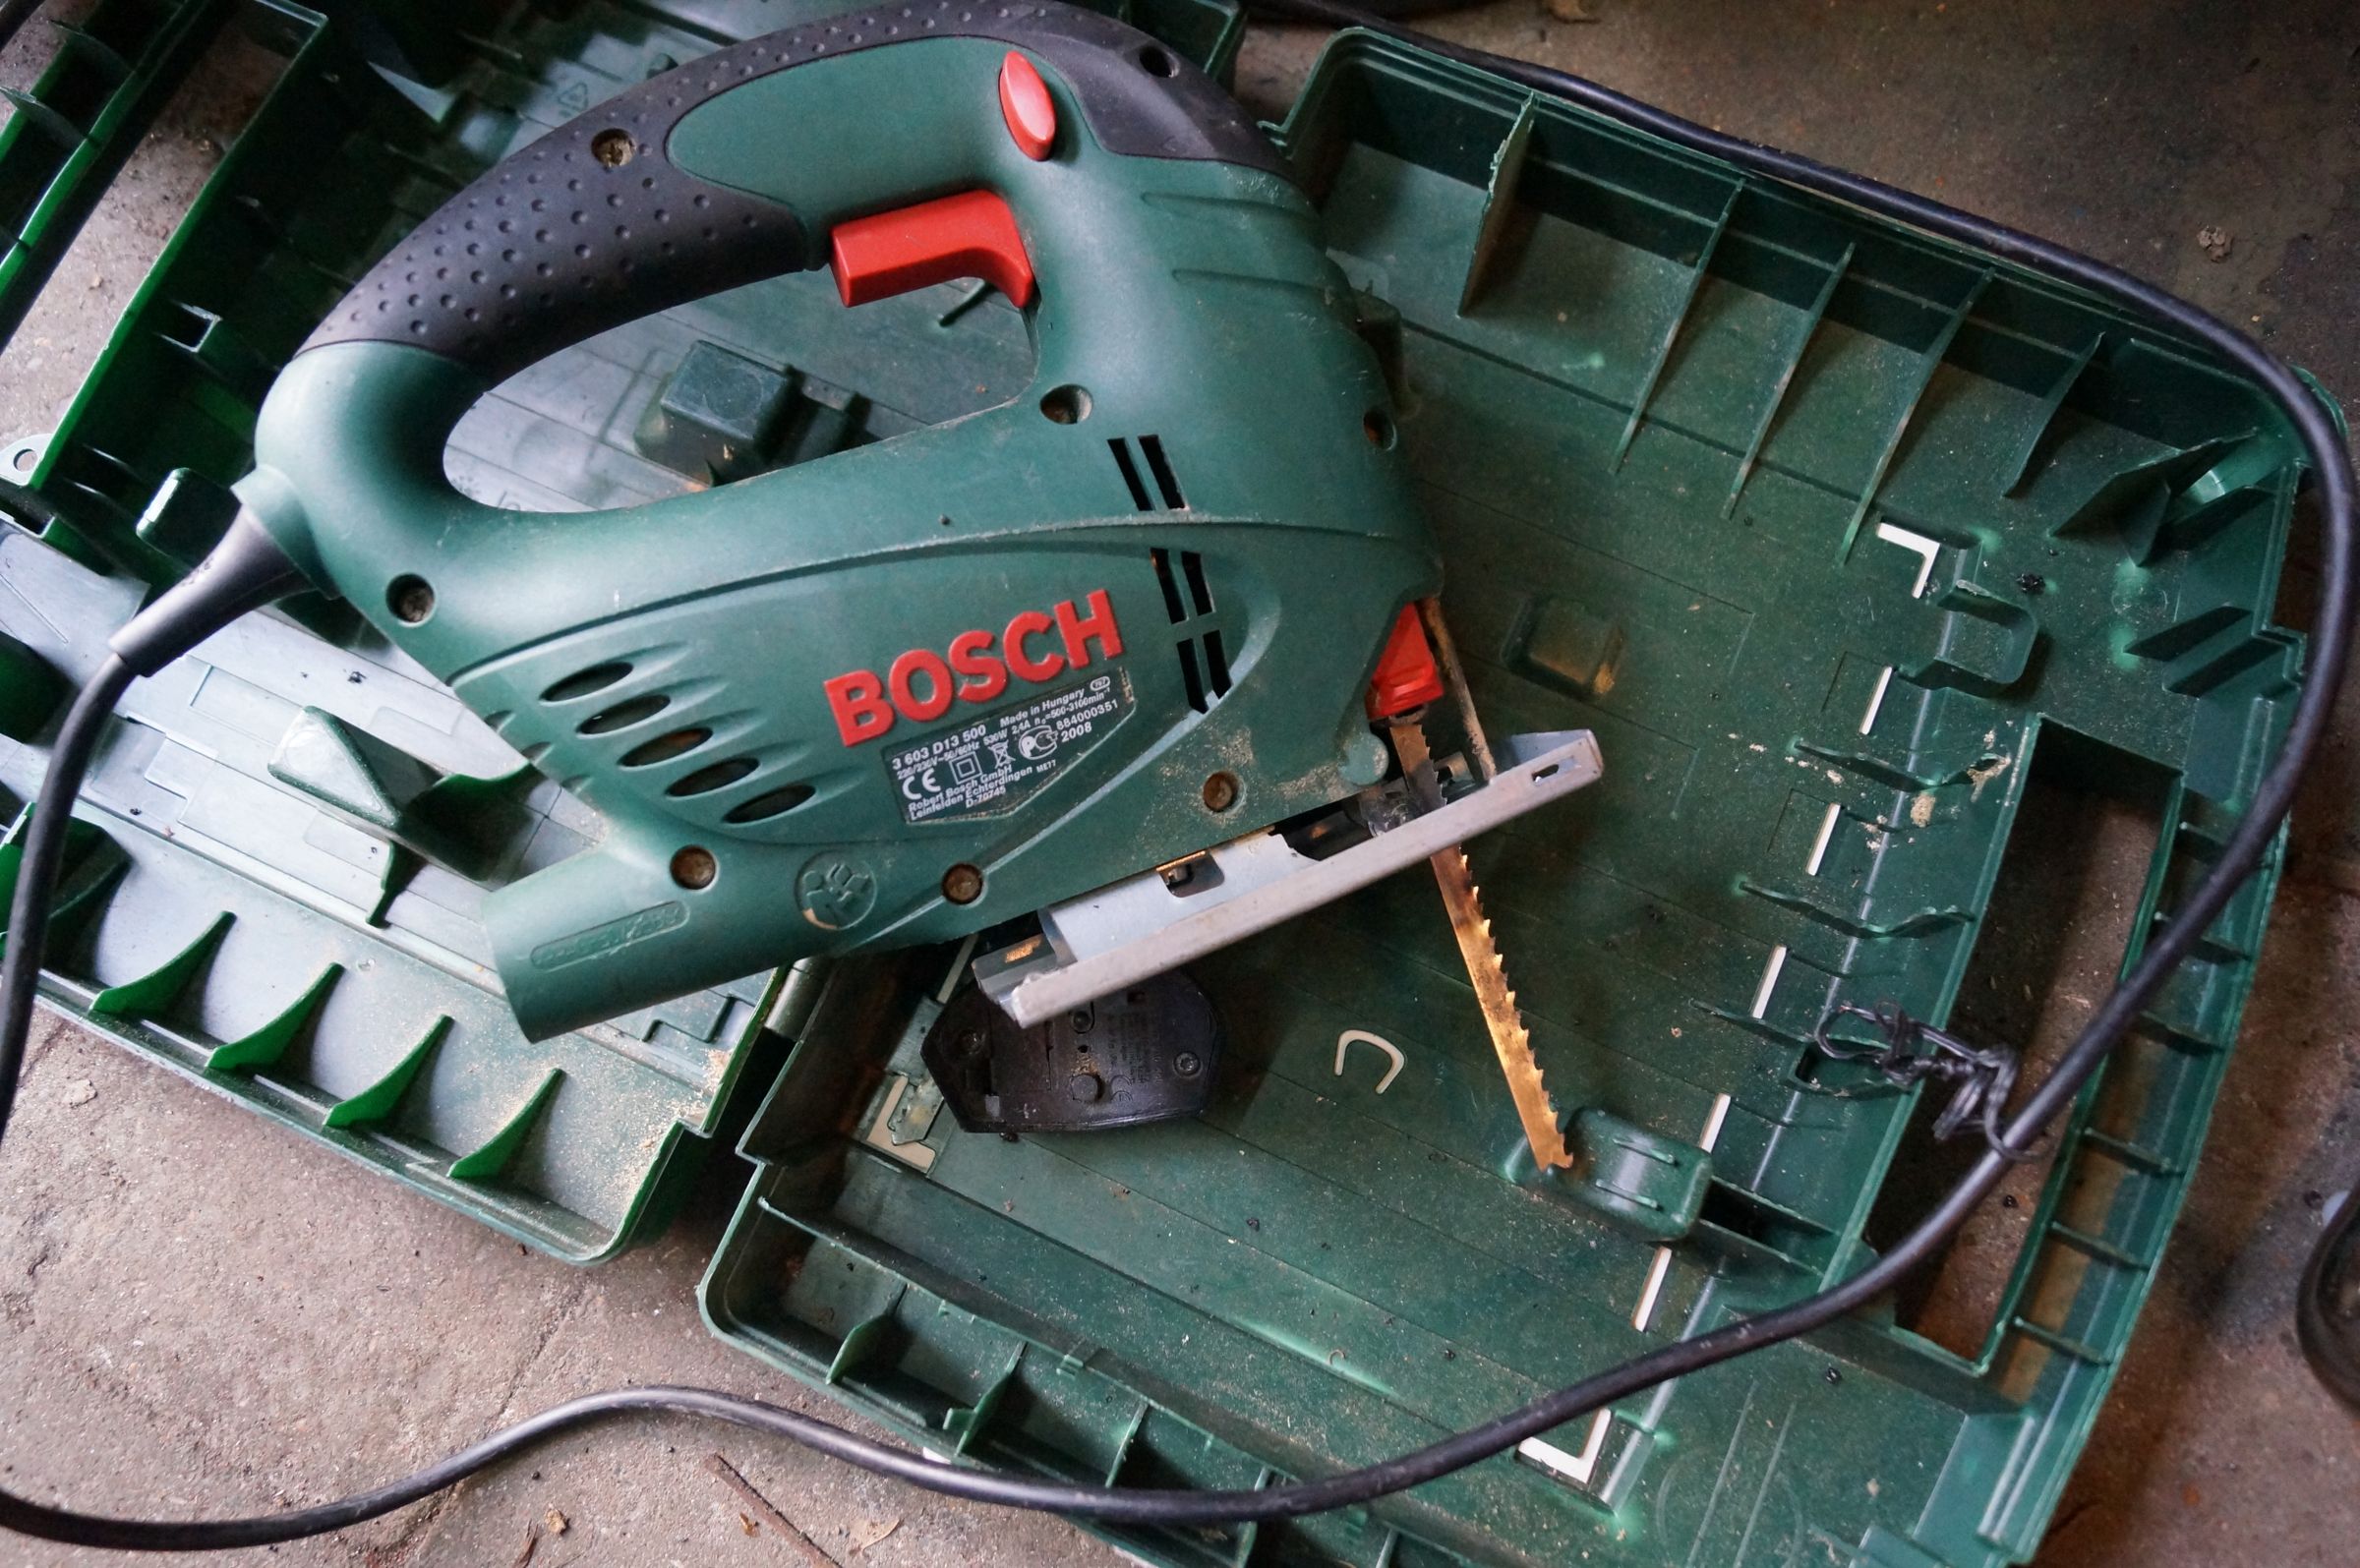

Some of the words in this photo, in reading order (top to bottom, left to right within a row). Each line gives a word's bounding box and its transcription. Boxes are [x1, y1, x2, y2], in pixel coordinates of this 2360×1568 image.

[824, 588, 1124, 747] BOSCH
[1000, 710, 1029, 728] Made
[1030, 703, 1040, 717] in
[1042, 688, 1085, 712] Hungary
[1056, 699, 1119, 730] 884000351
[892, 757, 903, 770] 3
[904, 747, 929, 766] 603
[932, 735, 959, 756] D13
[962, 725, 987, 743] 500
[1060, 723, 1092, 743] 2008
[902, 767, 942, 800] CE
[909, 791, 945, 813] Robert
[946, 780, 978, 797] Bosch
[979, 764, 1013, 784] GmbH
[910, 793, 964, 822] Leinfelden
[965, 766, 1033, 798] Echterdingen
